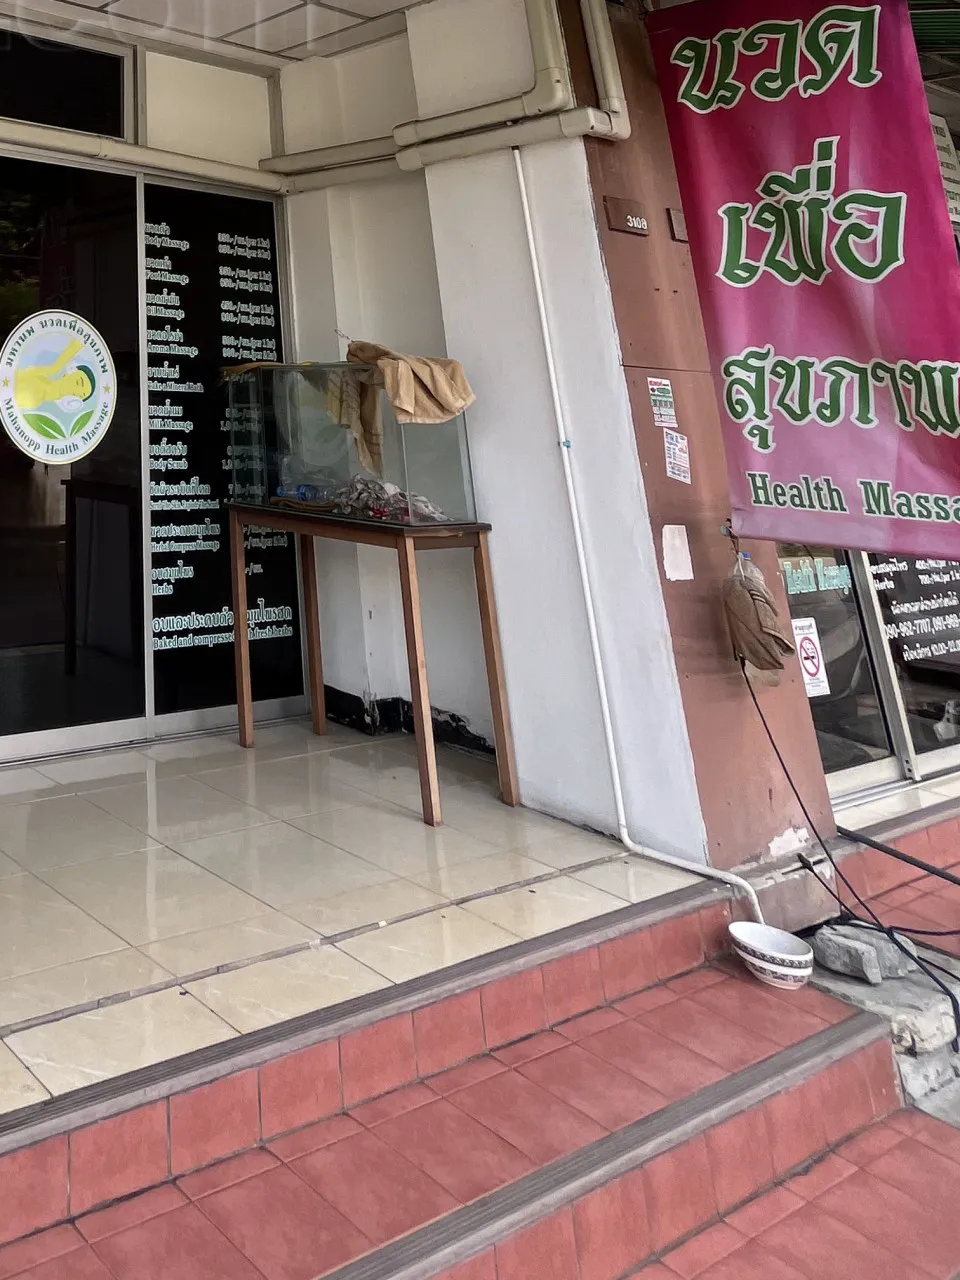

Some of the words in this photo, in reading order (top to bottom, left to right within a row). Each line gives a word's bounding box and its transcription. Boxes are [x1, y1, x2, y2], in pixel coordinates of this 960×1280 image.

[670, 3, 883, 115] นวด
[716, 135, 909, 288] เพื่อ
[162, 237, 190, 251] Massage
[162, 271, 189, 285] Massage
[157, 307, 185, 320] Massage
[148, 342, 170, 353] Aroma
[170, 344, 198, 358] Massage
[720, 343, 960, 454] สุขภาพ
[4, 397, 41, 452] Mahanopp
[45, 443, 80, 456] Health
[82, 401, 109, 444] Massage
[164, 419, 193, 433] Massage
[149, 458, 167, 472] Body
[167, 458, 188, 470] Scrub
[748, 472, 849, 515] Health
[152, 583, 174, 596] Herbs
[152, 635, 177, 650] Baked
[178, 633, 193, 647] and
